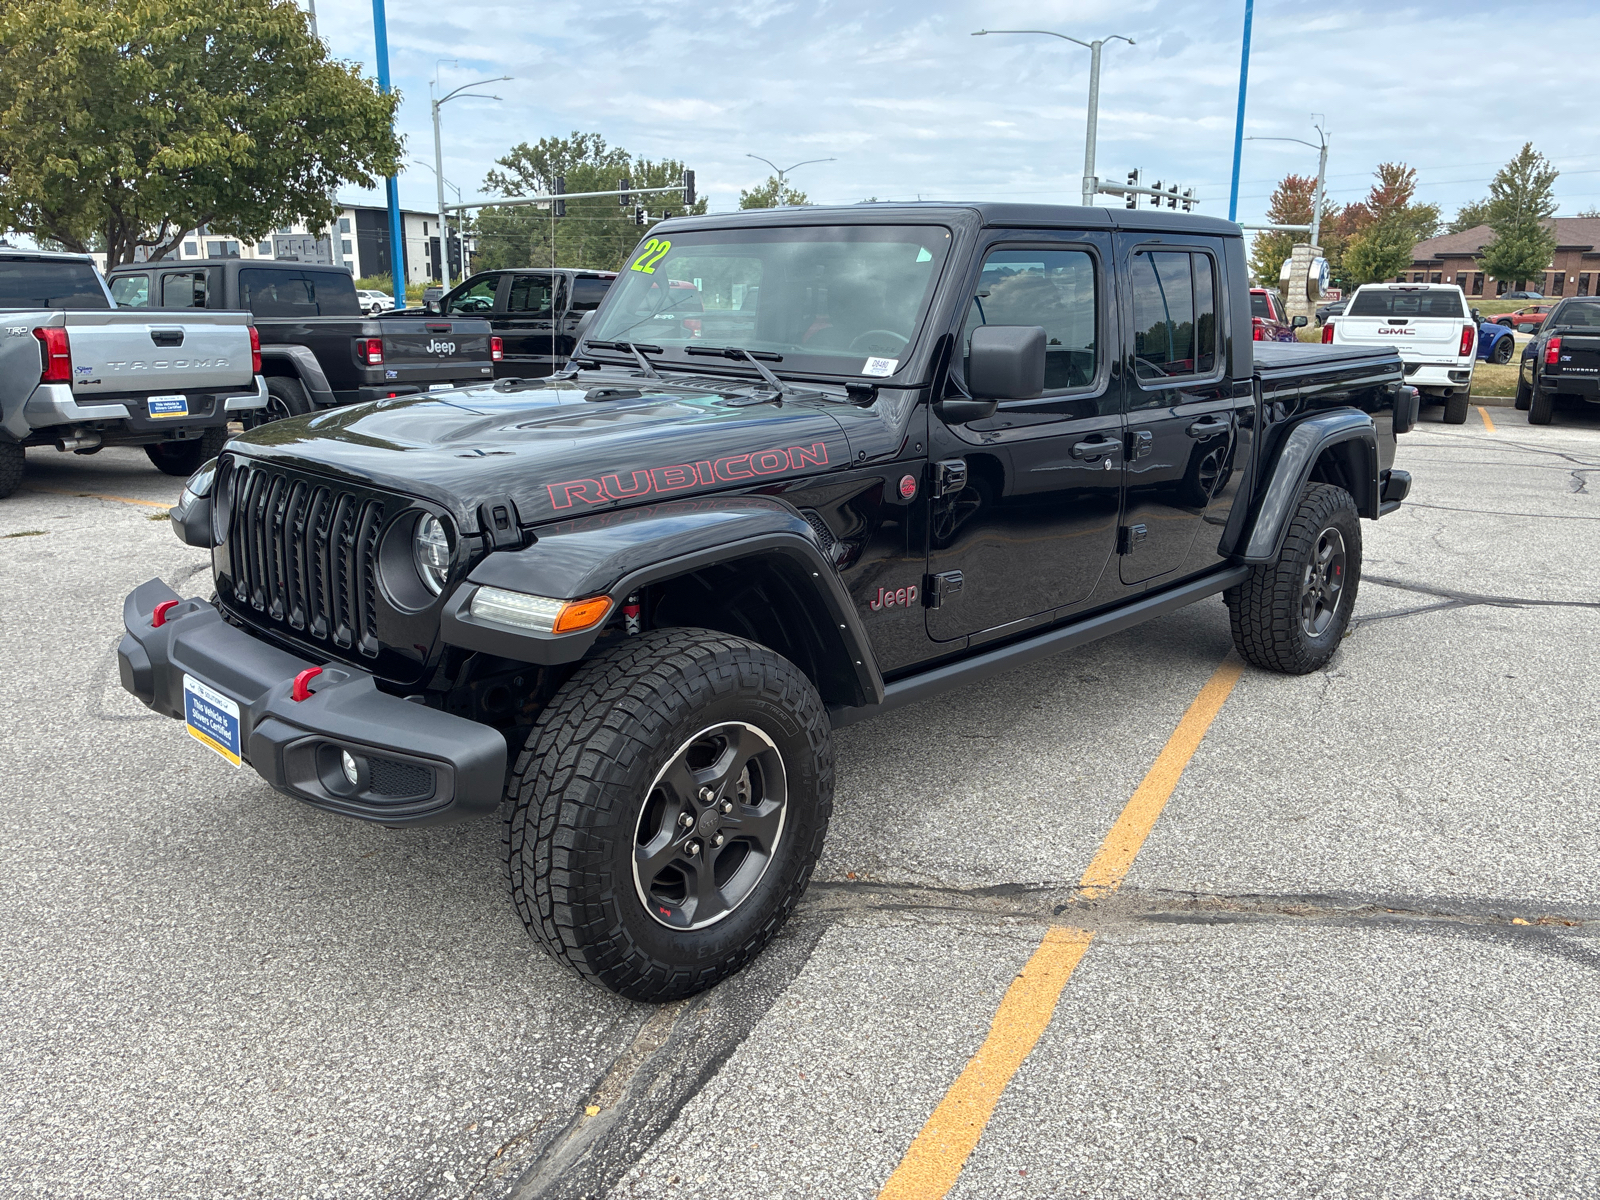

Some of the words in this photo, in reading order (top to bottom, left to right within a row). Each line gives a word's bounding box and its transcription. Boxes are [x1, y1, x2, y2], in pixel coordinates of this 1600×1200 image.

[631, 238, 672, 275] 22
[5, 326, 28, 335] TRD
[1378, 327, 1416, 335] GMC
[426, 339, 456, 356] Jeep
[106, 358, 230, 371] TACOMA
[546, 442, 829, 510] RUBICON
[870, 585, 918, 611] Jeep
[193, 697, 204, 713] This
[204, 703, 223, 724] Vehicle
[192, 707, 210, 727] Stivers
[210, 718, 232, 741] Certified
